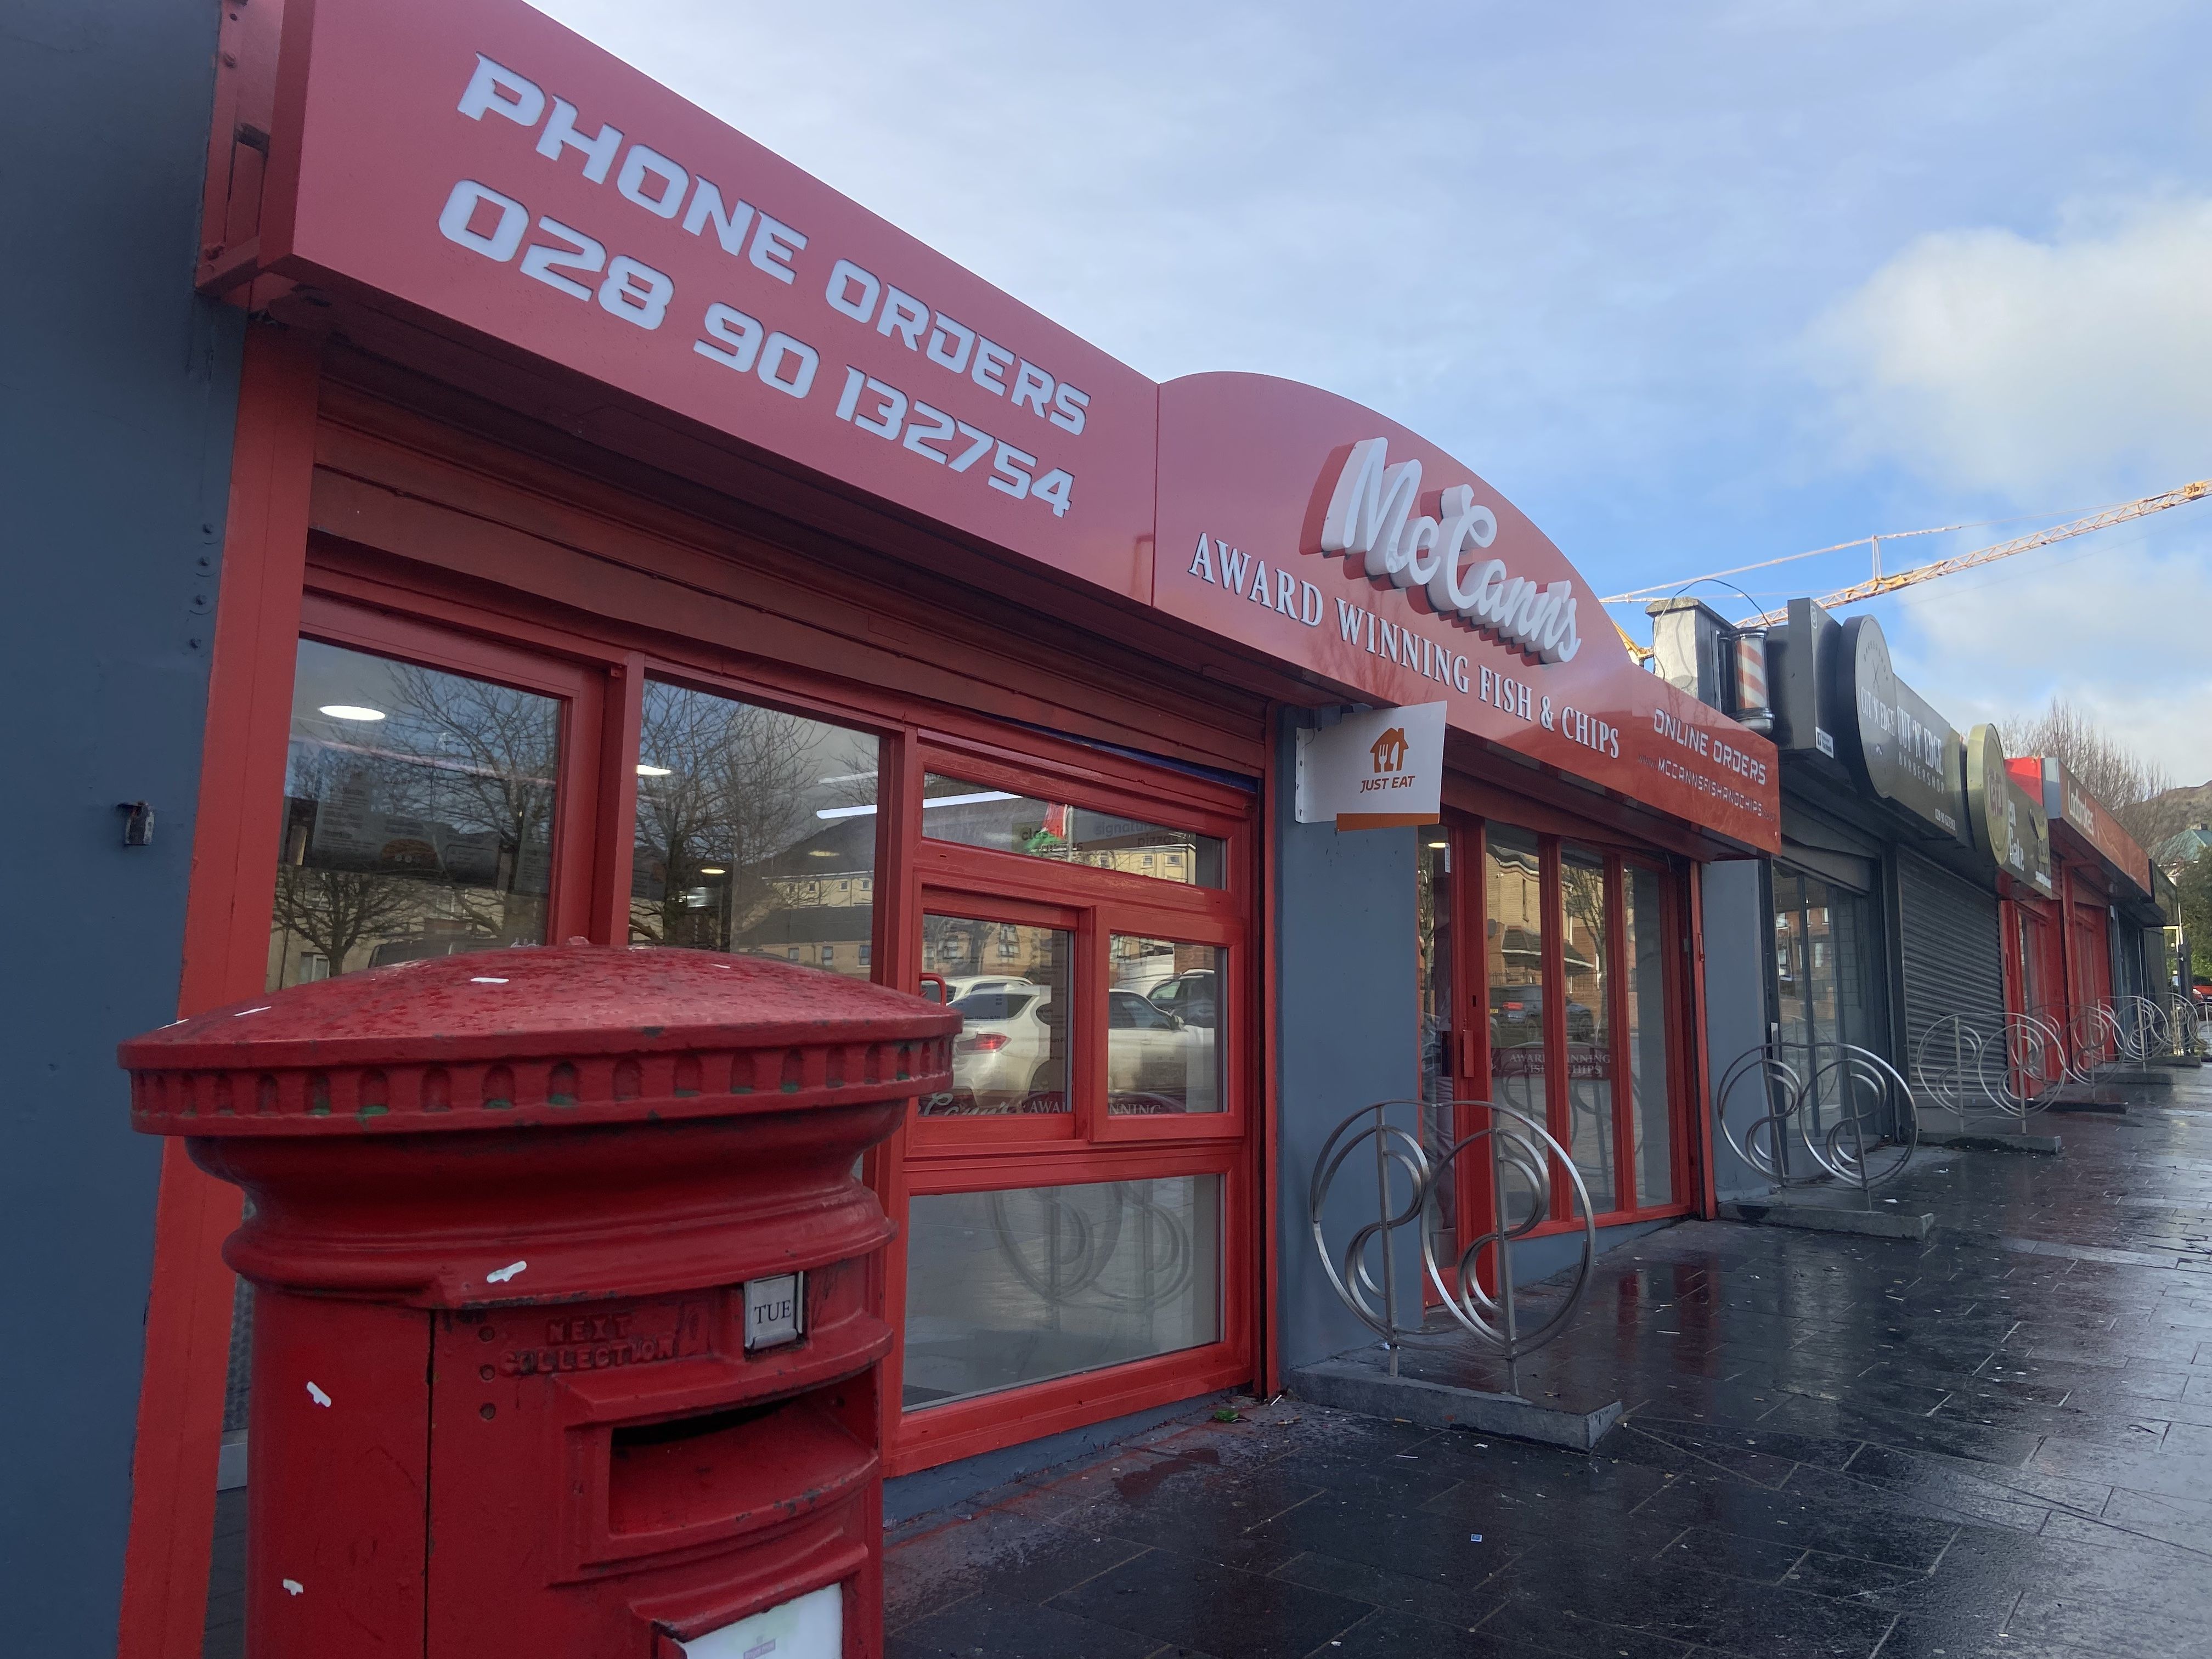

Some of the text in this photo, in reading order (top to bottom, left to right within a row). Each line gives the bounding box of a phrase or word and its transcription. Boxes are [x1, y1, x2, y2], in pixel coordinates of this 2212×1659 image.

[457, 51, 1091, 436] PHONE ORDERS
[439, 179, 1075, 518] 028 90 132754
[1321, 437, 1581, 664] McCann's
[1188, 532, 1619, 758] AWARD WINNING FISH & CHIPS
[1654, 708, 1767, 786] ONLINE ORDERS
[1897, 706, 1911, 752] CUT
[1923, 727, 1944, 776] EDGE
[1898, 751, 1944, 795] BARBERSHOP
[1360, 775, 1415, 793] JUST EAT
[549, 1314, 631, 1345] NEXT
[754, 1300, 792, 1324] TUE
[500, 1335, 674, 1374] COLLECTION
